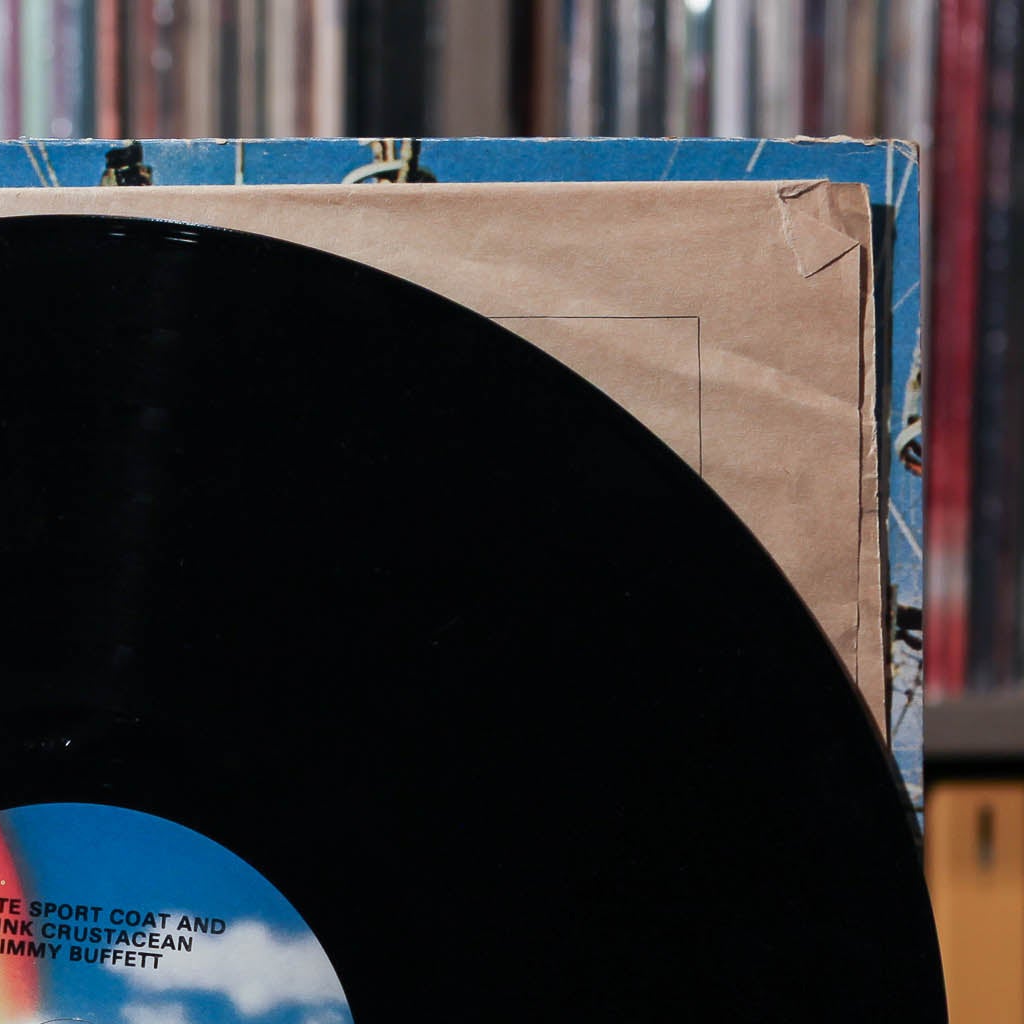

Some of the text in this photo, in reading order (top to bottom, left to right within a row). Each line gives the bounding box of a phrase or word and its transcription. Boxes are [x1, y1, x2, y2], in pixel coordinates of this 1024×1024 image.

[29, 901, 103, 923] SPORT
[110, 908, 171, 930] COAT
[177, 915, 226, 935] AND
[41, 922, 193, 952] CRUSTACEAN
[69, 948, 163, 970] BUFFETT
